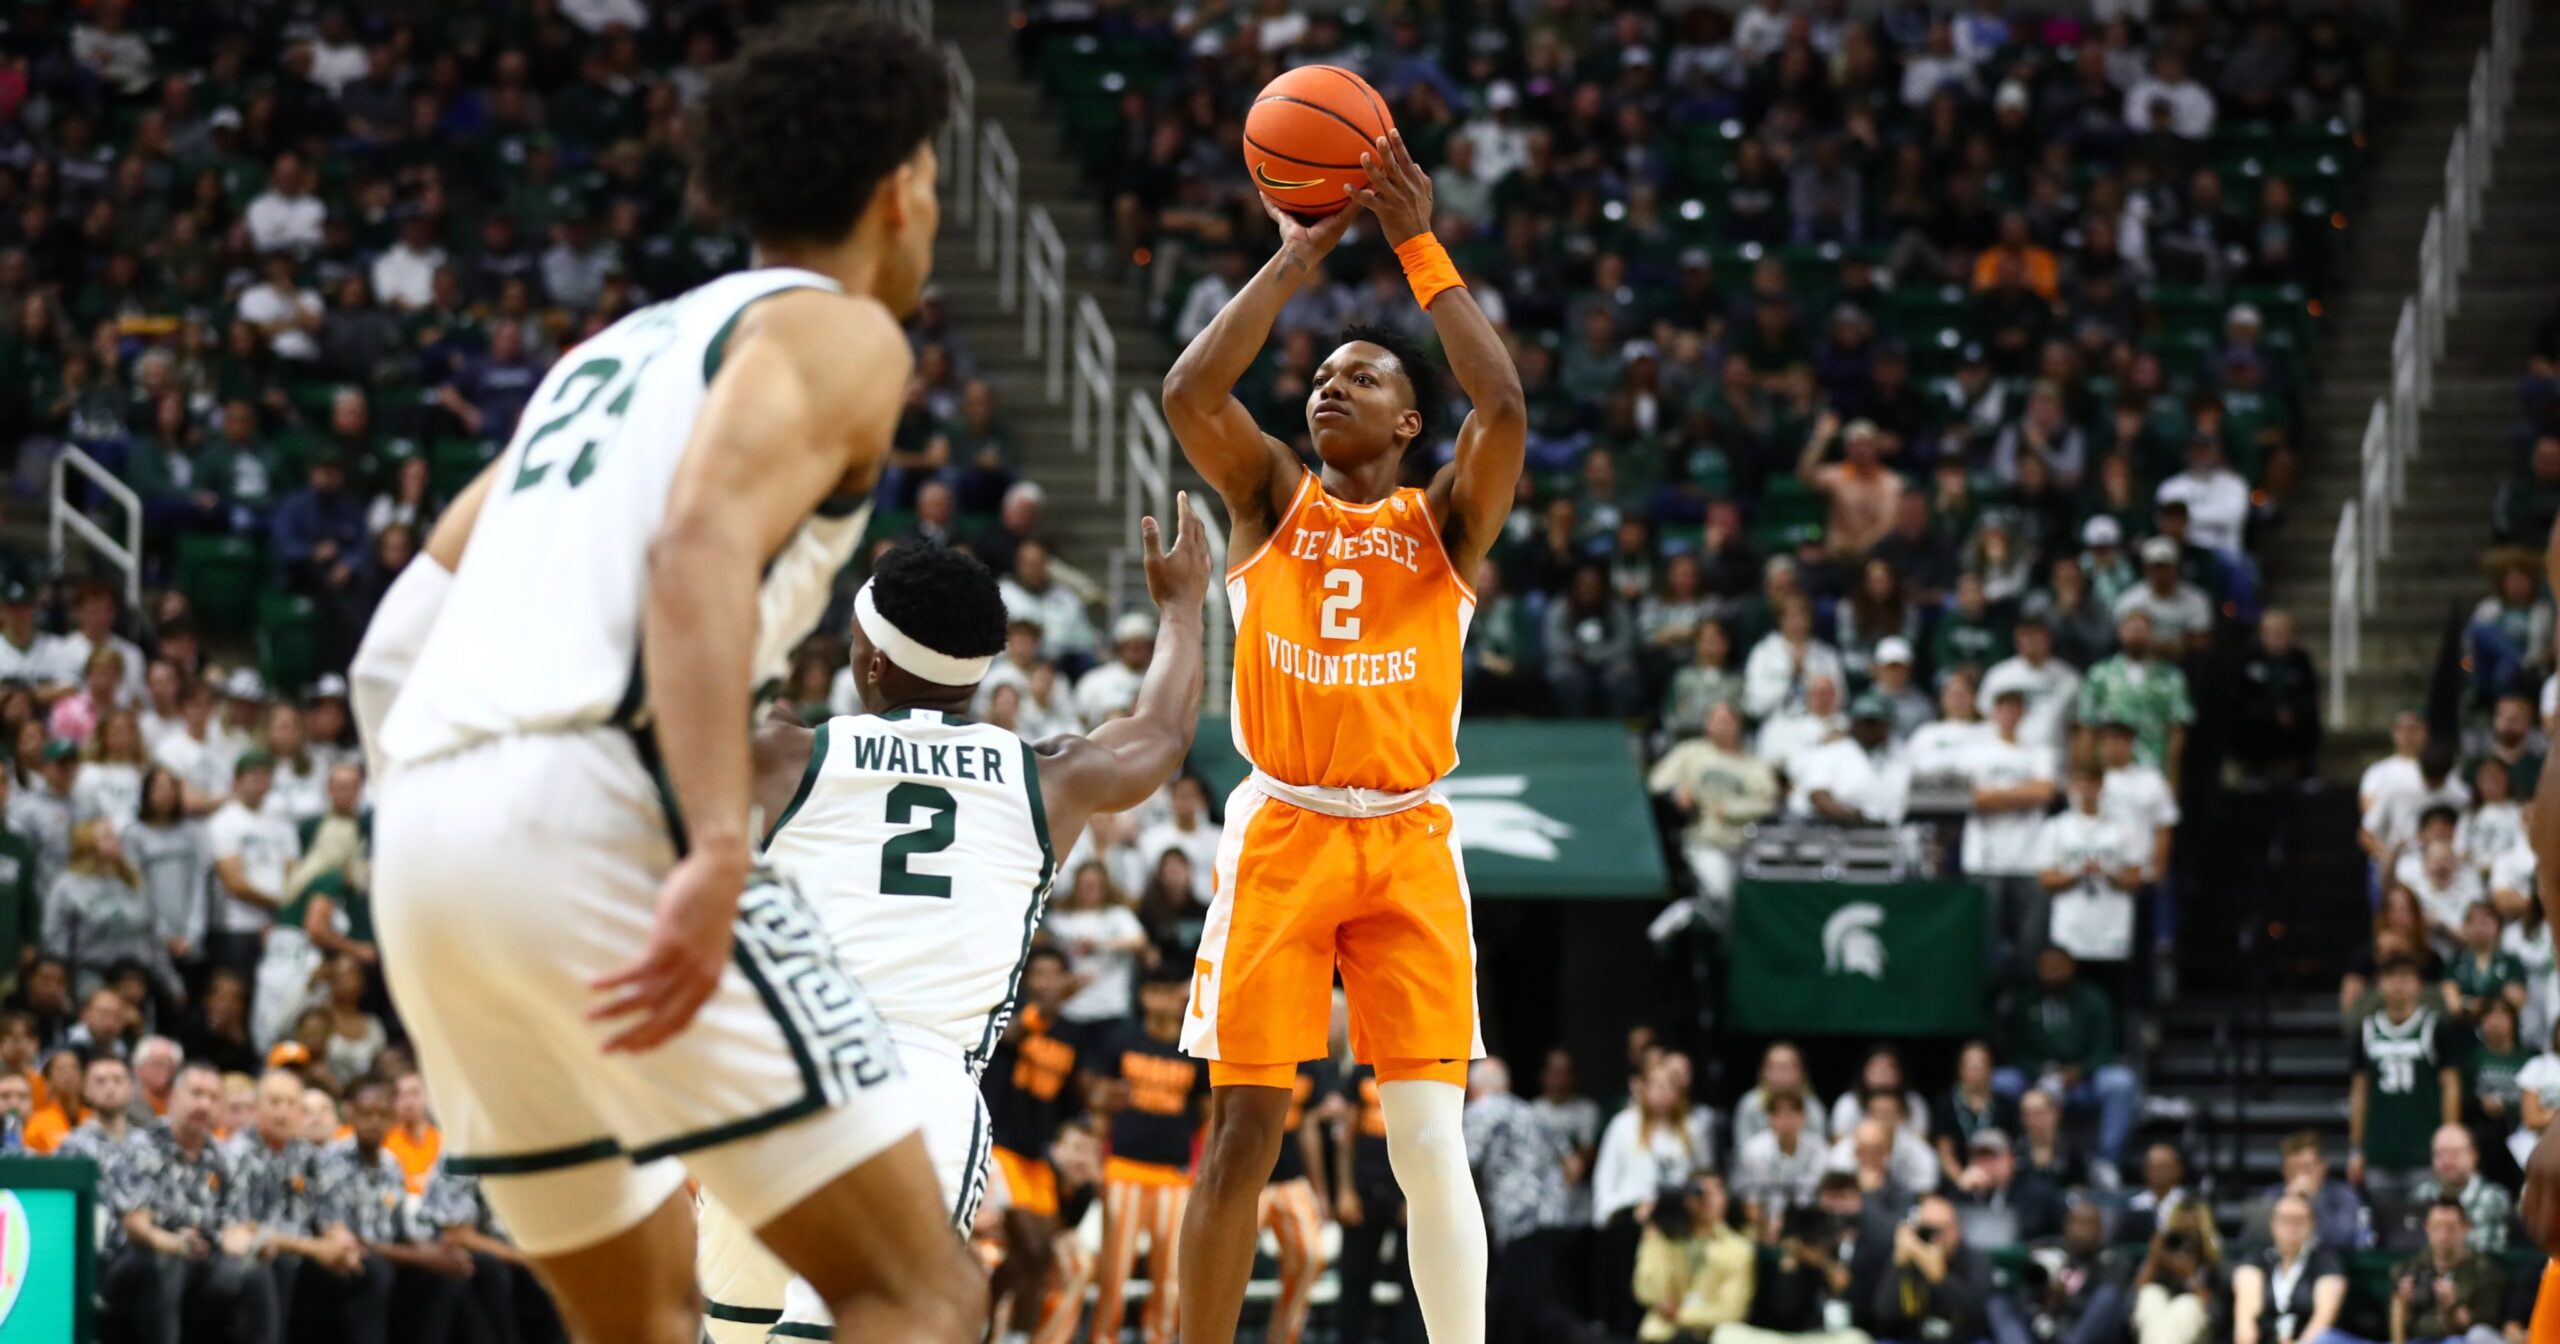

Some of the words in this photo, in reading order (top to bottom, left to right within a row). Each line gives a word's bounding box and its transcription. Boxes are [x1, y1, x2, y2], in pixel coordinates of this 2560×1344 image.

[1291, 527, 1420, 573] TENESSEE
[1320, 568, 1363, 640] 2
[1266, 631, 1417, 687] VOLUNTEERS
[853, 734, 1006, 784] WALKER
[879, 781, 957, 899] 2
